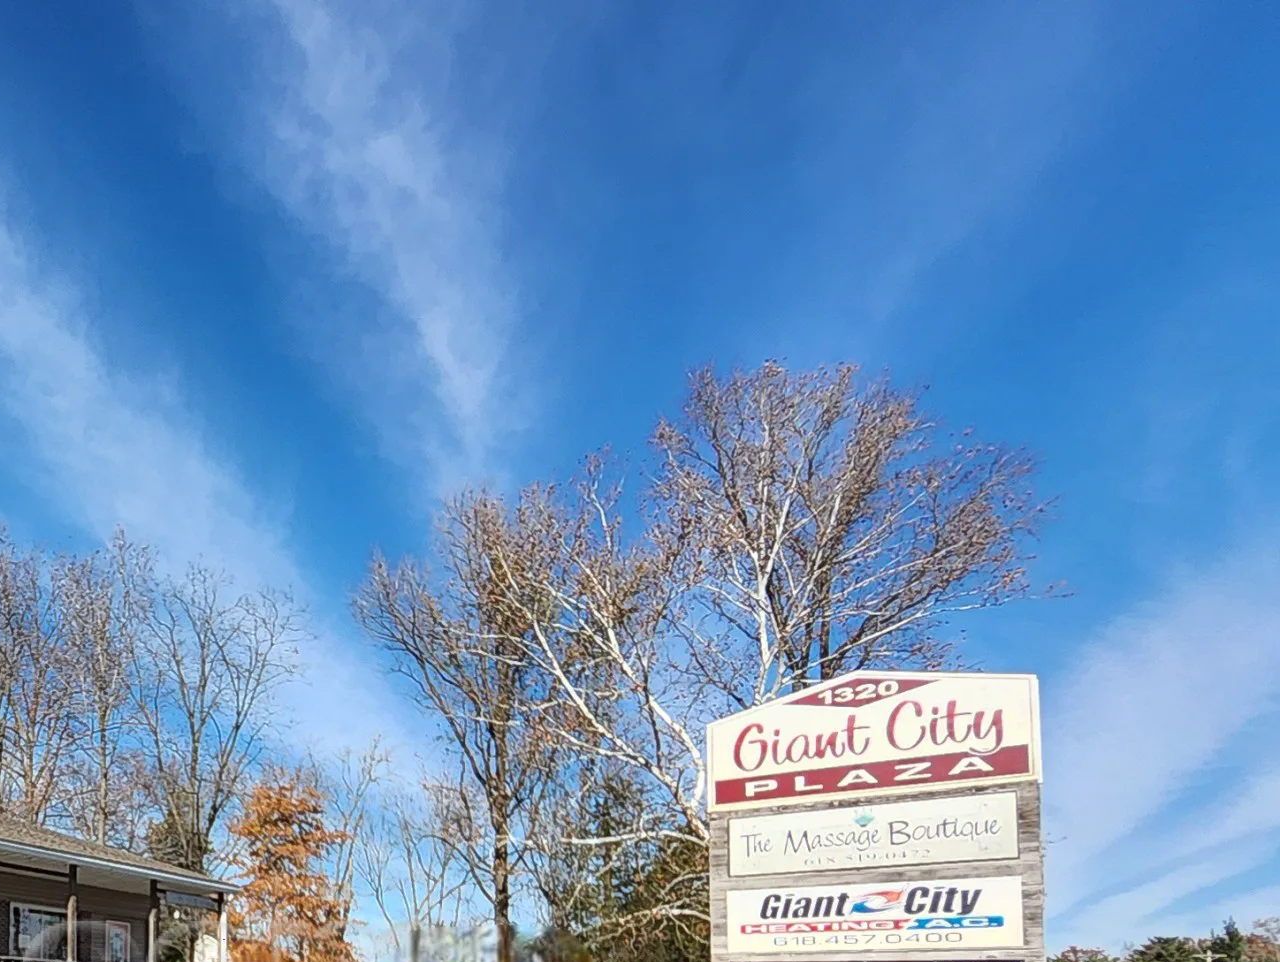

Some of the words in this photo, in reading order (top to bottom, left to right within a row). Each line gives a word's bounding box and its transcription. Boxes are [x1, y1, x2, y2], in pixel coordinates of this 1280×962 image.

[818, 680, 899, 704] 1320
[733, 714, 871, 772] Giant
[886, 700, 1003, 754] City
[745, 756, 995, 797] PLAZA
[740, 833, 773, 857] The
[783, 829, 881, 855] Massage
[888, 818, 1001, 845] Boutique
[760, 892, 850, 919] Giant
[904, 886, 982, 915] City
[745, 920, 895, 933] HEATING
[925, 917, 998, 929] A.C.
[773, 932, 963, 946] 618.457.0400
